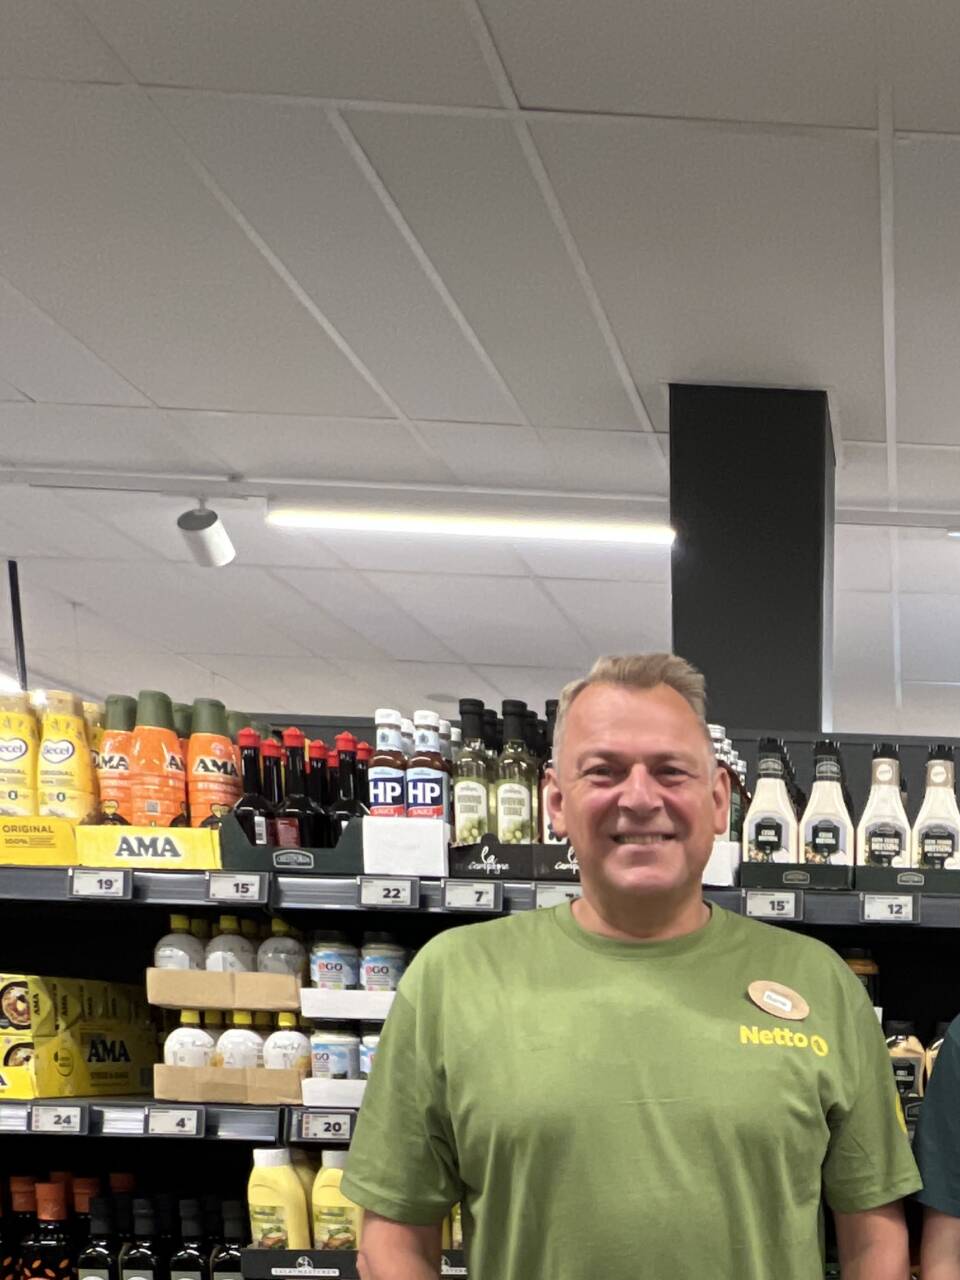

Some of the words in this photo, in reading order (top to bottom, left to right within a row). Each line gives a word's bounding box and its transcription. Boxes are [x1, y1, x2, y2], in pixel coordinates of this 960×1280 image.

[370, 782, 401, 803] HP
[408, 782, 440, 803] HP
[2, 825, 54, 833] ORIGINAL
[115, 836, 182, 857] AMA
[96, 879, 113, 890] 19
[233, 882, 250, 894] 15
[382, 887, 401, 899] 22
[474, 891, 484, 903] 7
[768, 900, 785, 912] 15
[887, 904, 903, 915] 12
[318, 962, 343, 972] ØGO
[365, 965, 389, 975] ØGO
[740, 1025, 809, 1048] Netto
[87, 1039, 131, 1063] AMA
[53, 1114, 72, 1126] 24
[175, 1117, 186, 1129] 4
[323, 1121, 342, 1133] 20
